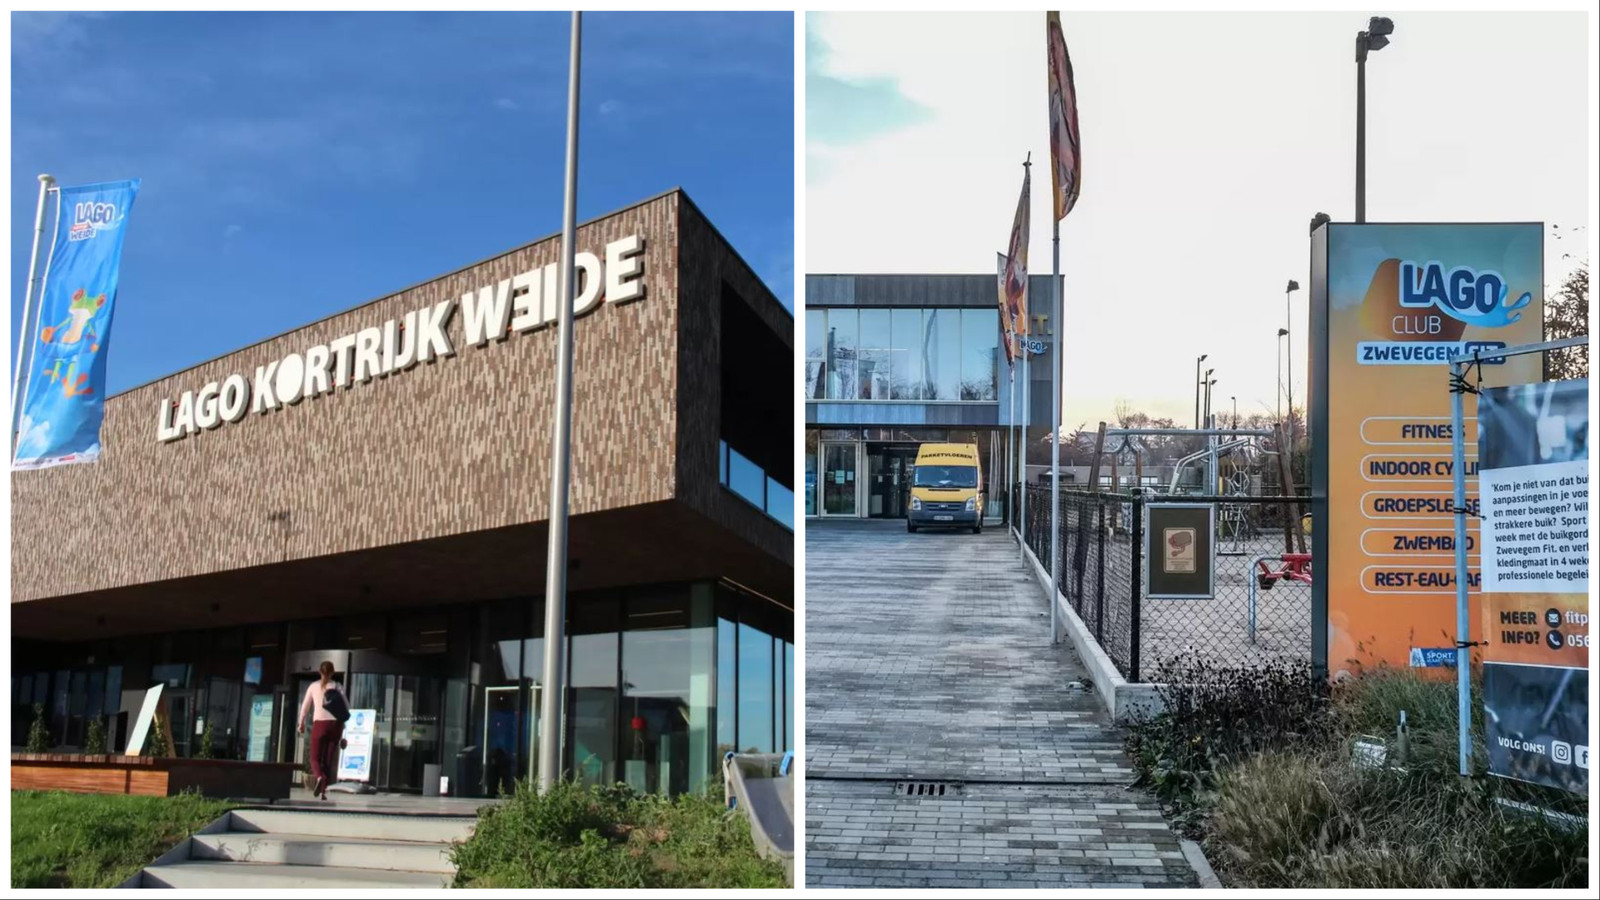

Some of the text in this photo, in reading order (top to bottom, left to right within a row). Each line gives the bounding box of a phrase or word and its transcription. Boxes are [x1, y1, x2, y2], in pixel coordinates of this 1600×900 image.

[75, 201, 115, 224] LAGO
[1401, 264, 1501, 313] LAGO
[1392, 315, 1441, 334] CLUB
[1363, 346, 1460, 360] ZWEVEGEM
[157, 374, 249, 442] LAGO
[252, 300, 454, 413] KORTRIJK
[1402, 424, 1465, 439] FITNES
[1369, 461, 1431, 476] INDOOR
[1513, 482, 1521, 492] je
[1523, 480, 1538, 490] niet
[1540, 479, 1557, 488] van
[1559, 476, 1574, 486] dat
[1492, 494, 1548, 505] aanpassingen
[1549, 491, 1558, 500] in
[1560, 490, 1570, 501] je
[1374, 498, 1480, 513] GROEPSLESE
[1493, 502, 1588, 518] en meer bewegen? Wil
[1494, 516, 1587, 530] strakkere buik? Sport
[1495, 528, 1589, 542] week met de buikgord
[1496, 546, 1541, 556] Zwevegem
[1542, 544, 1558, 553] Fit.
[1496, 558, 1548, 569] kledingmaat
[1550, 557, 1559, 566] in
[1560, 556, 1567, 565] 4
[1498, 569, 1589, 582] professionele begelei
[1500, 611, 1537, 625] MEER
[1501, 630, 1540, 645] INFO?
[1497, 736, 1546, 755] VOLG ONS!
